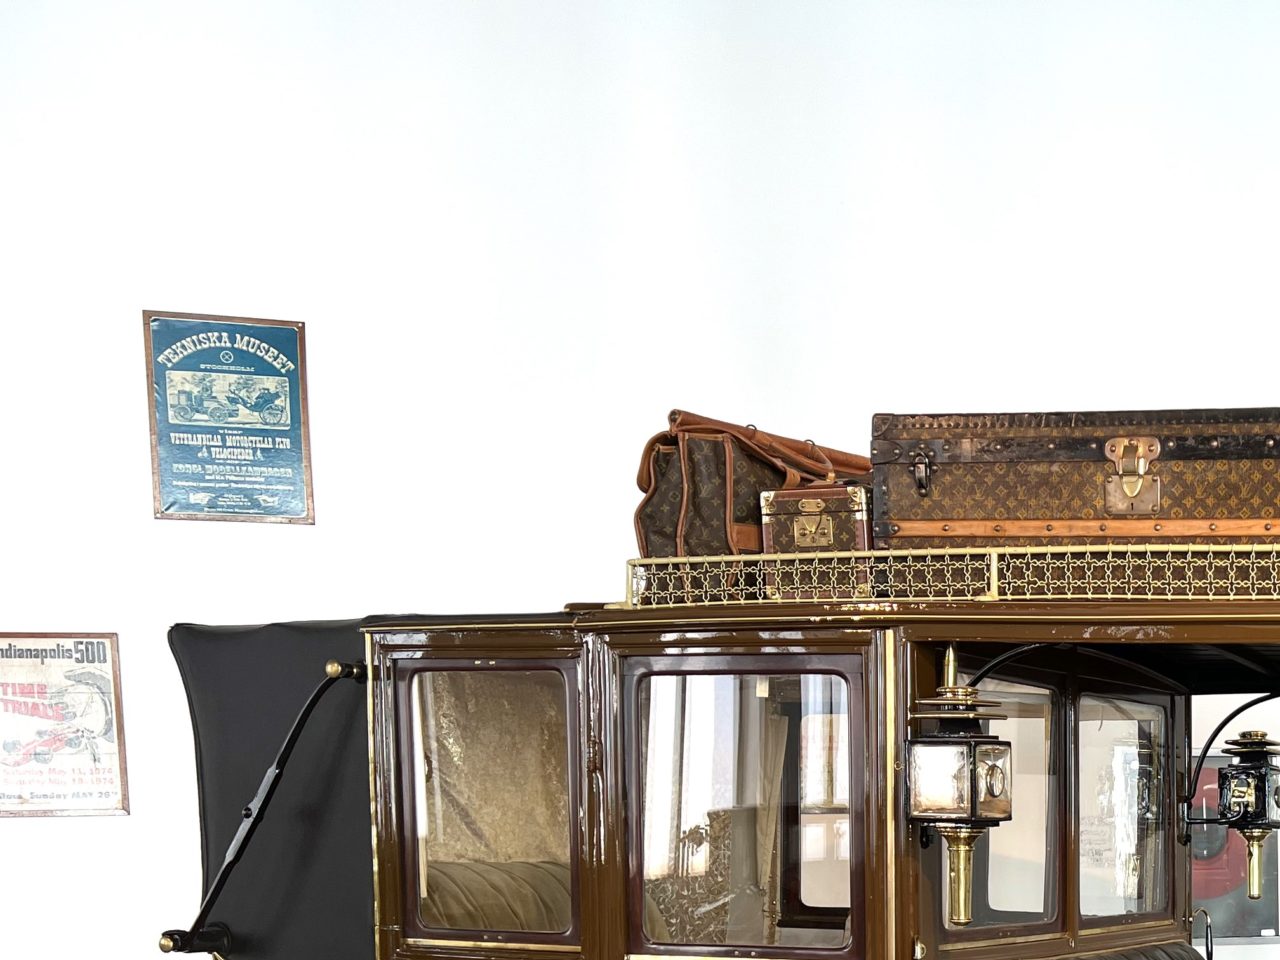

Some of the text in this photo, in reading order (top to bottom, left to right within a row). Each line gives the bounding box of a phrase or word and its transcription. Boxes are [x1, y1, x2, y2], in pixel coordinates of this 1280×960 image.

[156, 331, 296, 375] TEKNISKA MUSEET
[0, 641, 107, 665] ndianapolis 500
[0, 682, 48, 700] TIME
[0, 698, 65, 722] TRIALS
